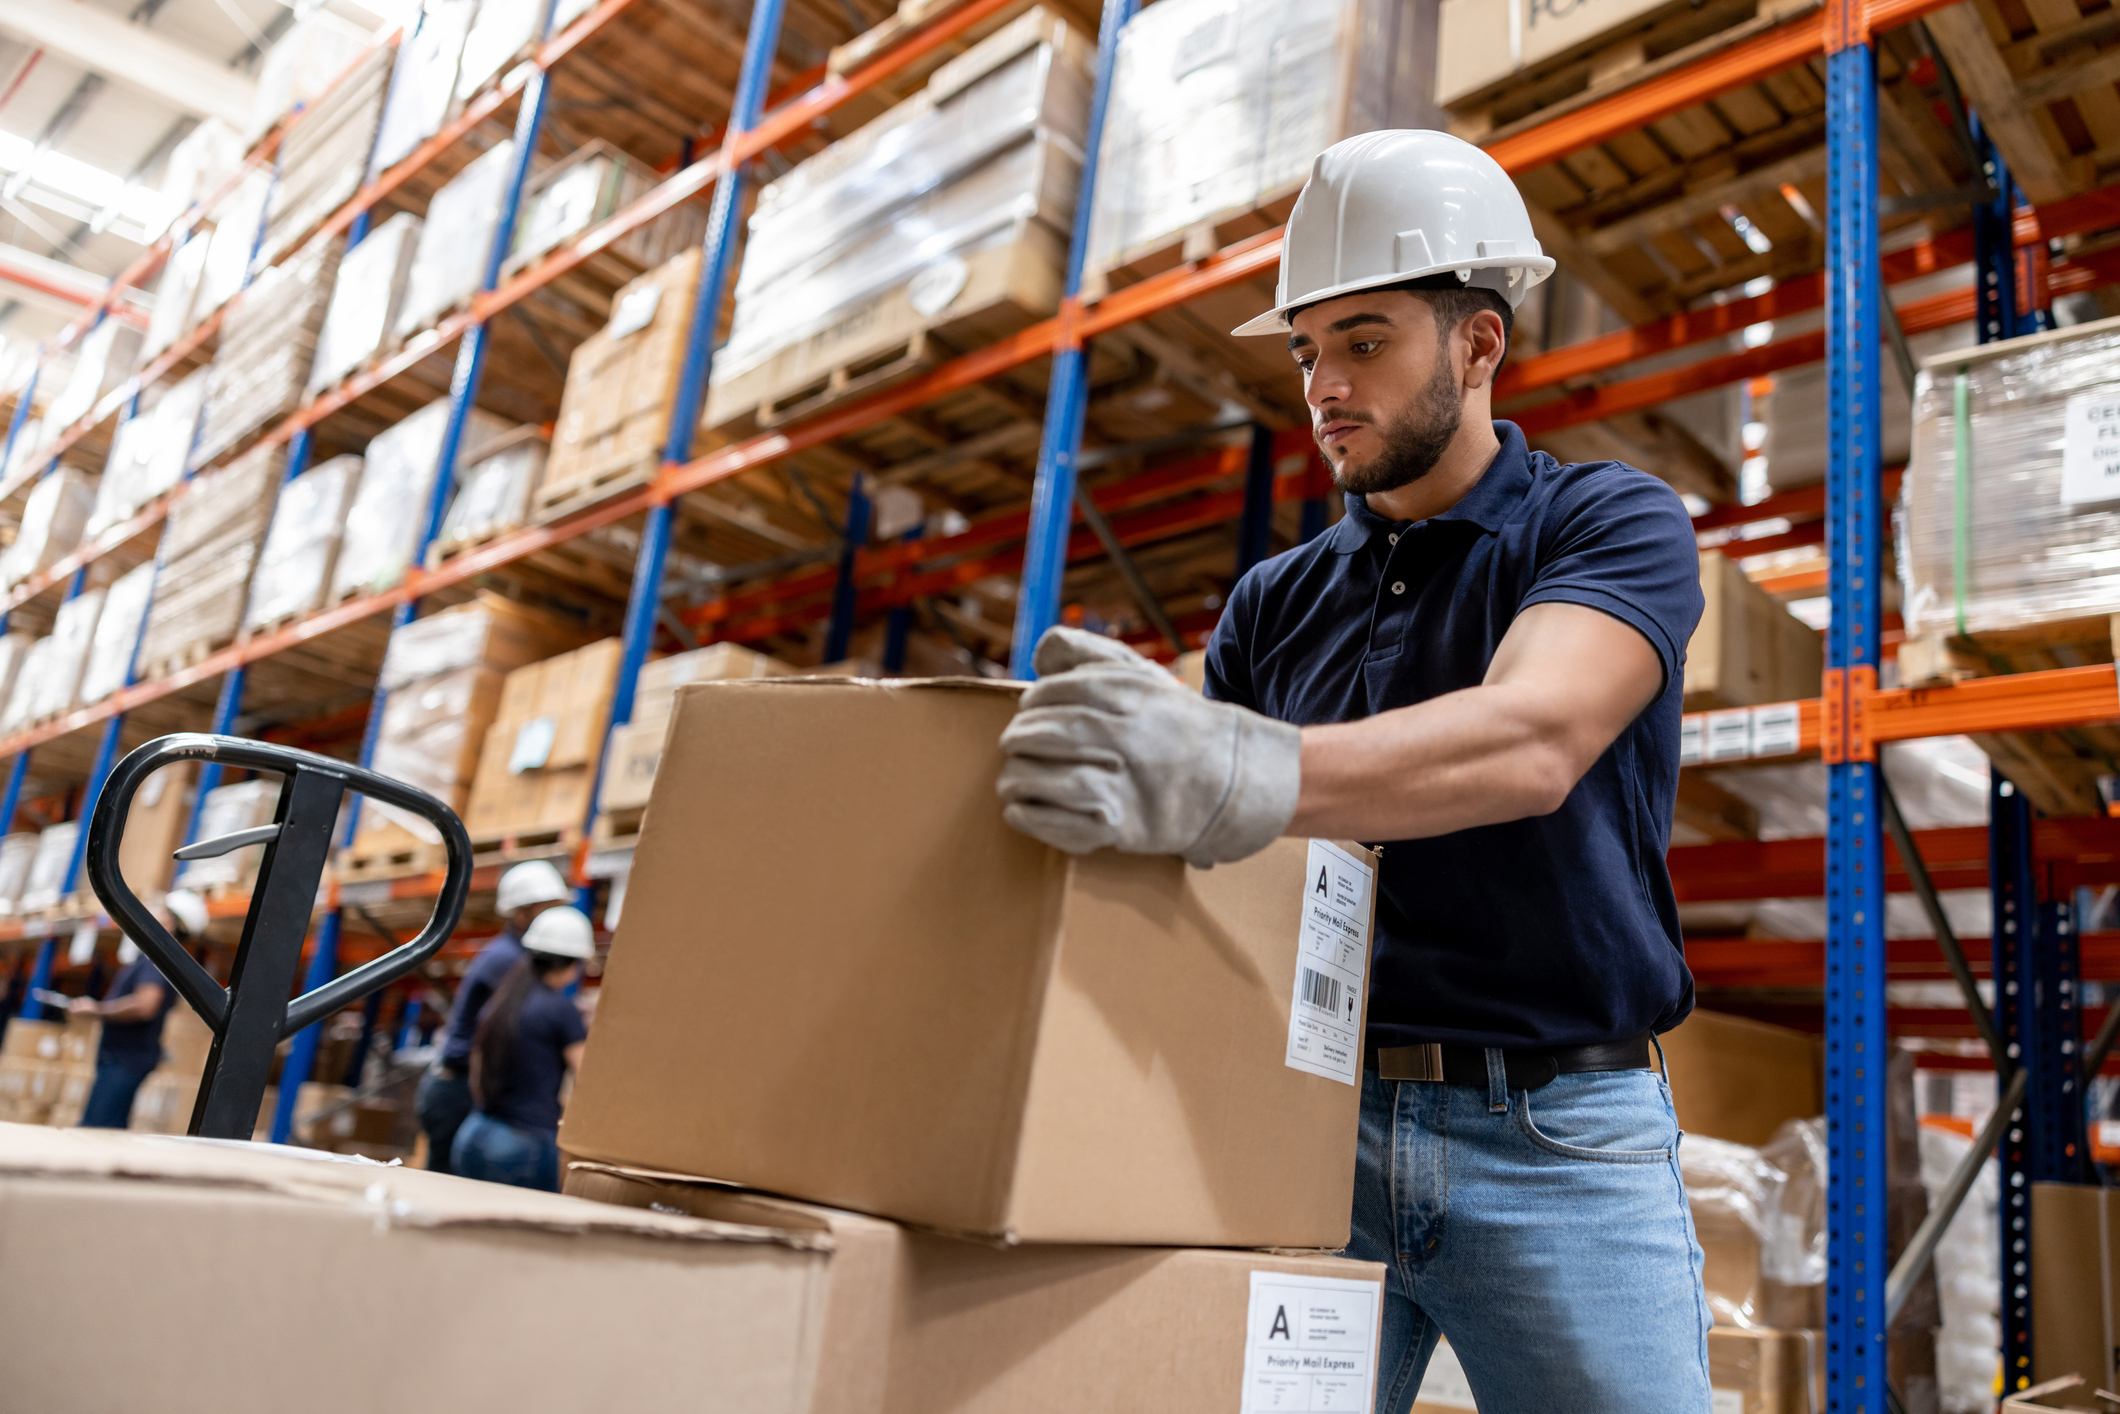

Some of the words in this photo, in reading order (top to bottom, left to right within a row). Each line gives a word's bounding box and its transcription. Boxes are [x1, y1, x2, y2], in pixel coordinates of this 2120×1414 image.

[1316, 865, 1327, 898] A
[1314, 907, 1332, 925] Priority
[1332, 916, 1342, 929] Mail
[1342, 922, 1360, 938] Express
[1269, 1305, 1290, 1340] A
[1268, 1356, 1300, 1371] Priority
[1303, 1357, 1322, 1368] Mail
[1324, 1358, 1355, 1372] Express
